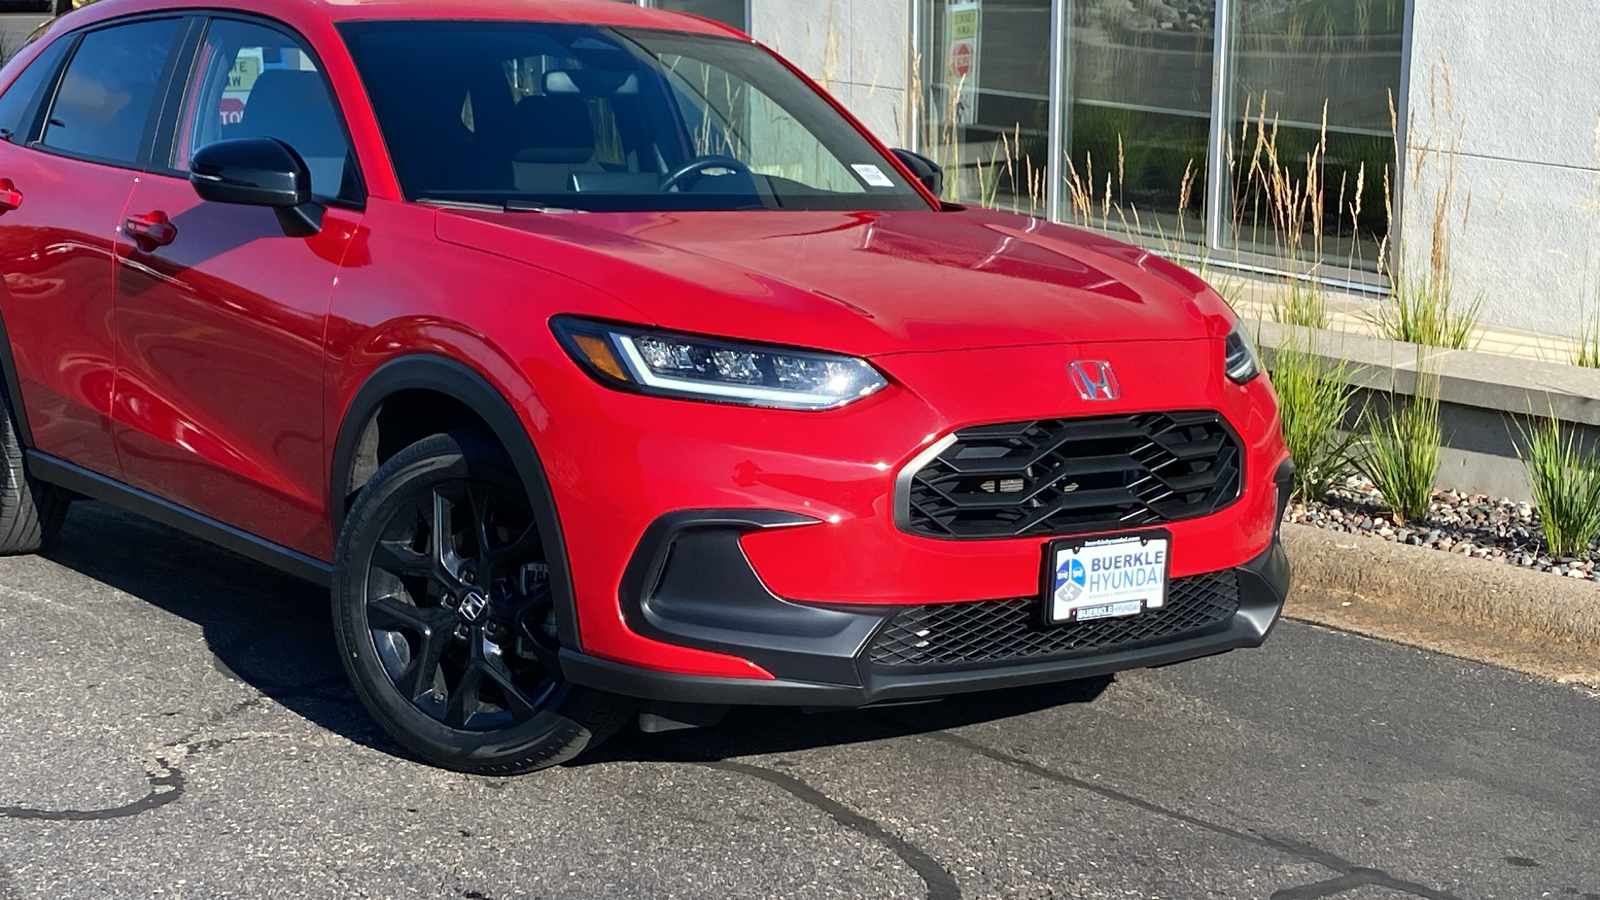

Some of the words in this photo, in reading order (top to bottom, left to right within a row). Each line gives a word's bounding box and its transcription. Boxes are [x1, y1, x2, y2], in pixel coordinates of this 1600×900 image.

[219, 111, 244, 125] TO
[1091, 551, 1164, 572] BUERKLE
[1089, 566, 1163, 593] HYUNDAI
[1078, 606, 1113, 618] BUERKLE
